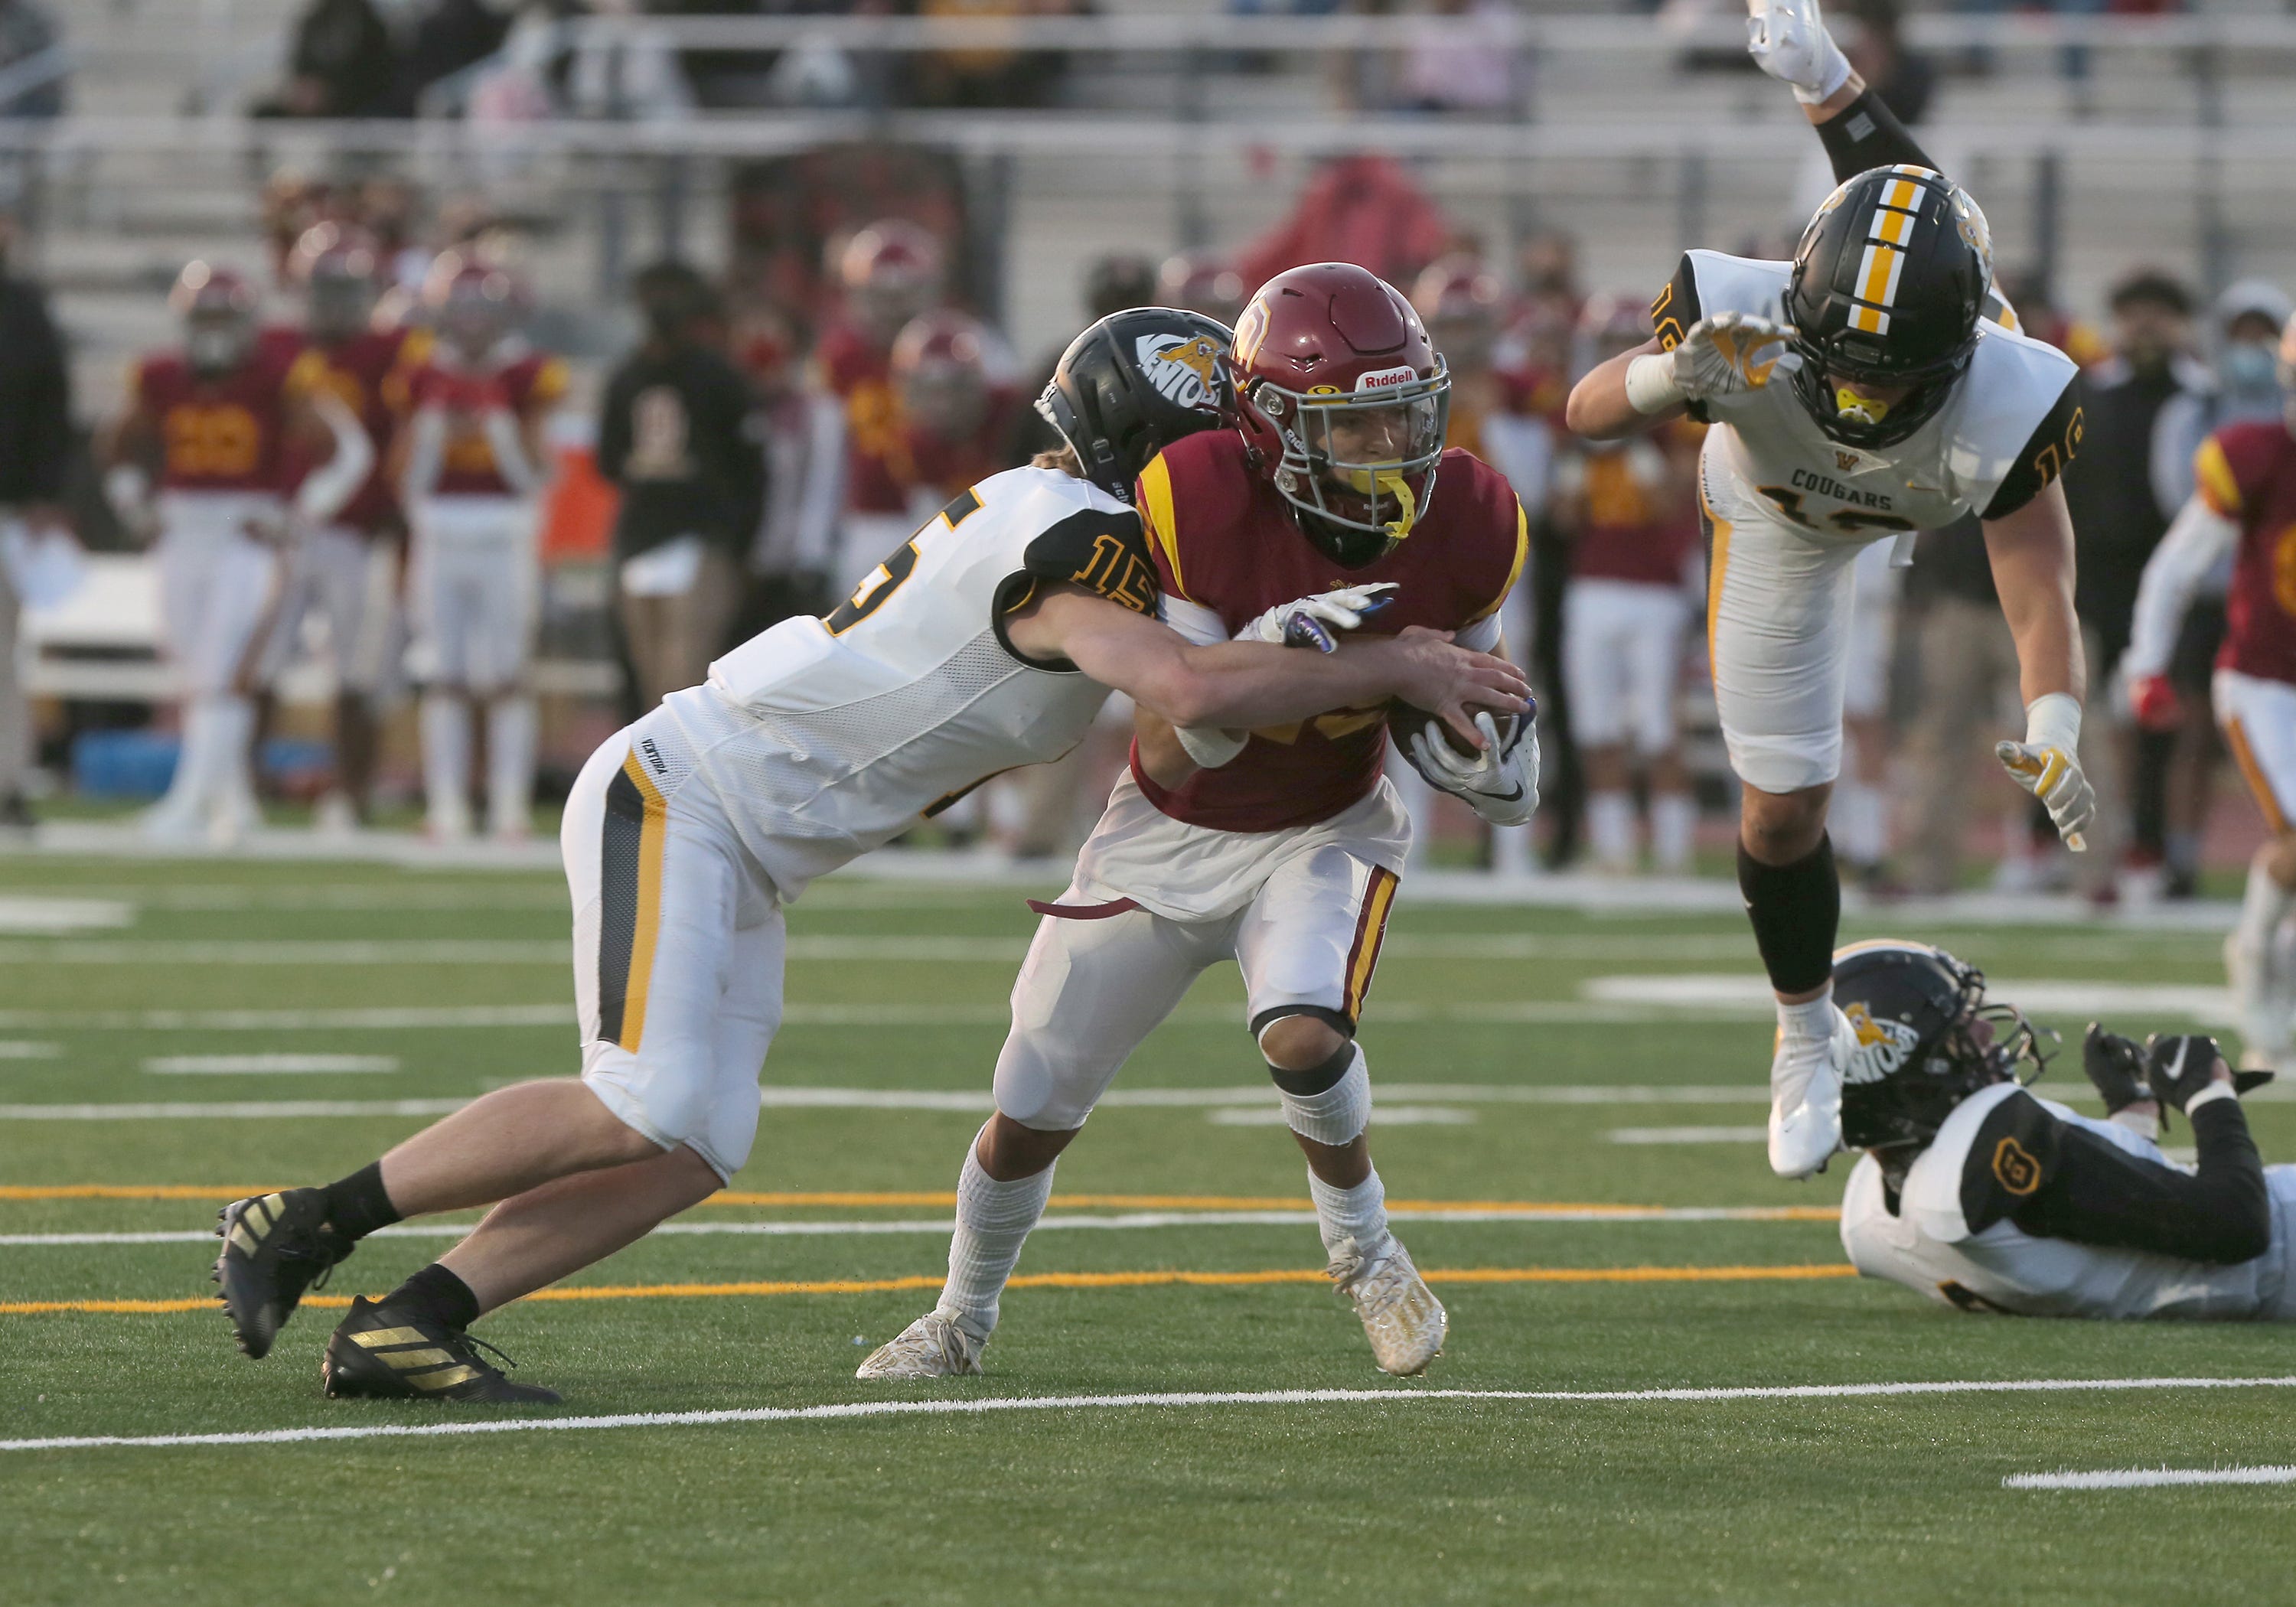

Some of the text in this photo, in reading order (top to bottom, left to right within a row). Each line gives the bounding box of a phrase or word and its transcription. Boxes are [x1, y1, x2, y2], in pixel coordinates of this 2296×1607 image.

[1365, 370, 1413, 389] Riddell
[1791, 468, 1893, 511] COUGARS
[641, 738, 668, 774] VENTURA
